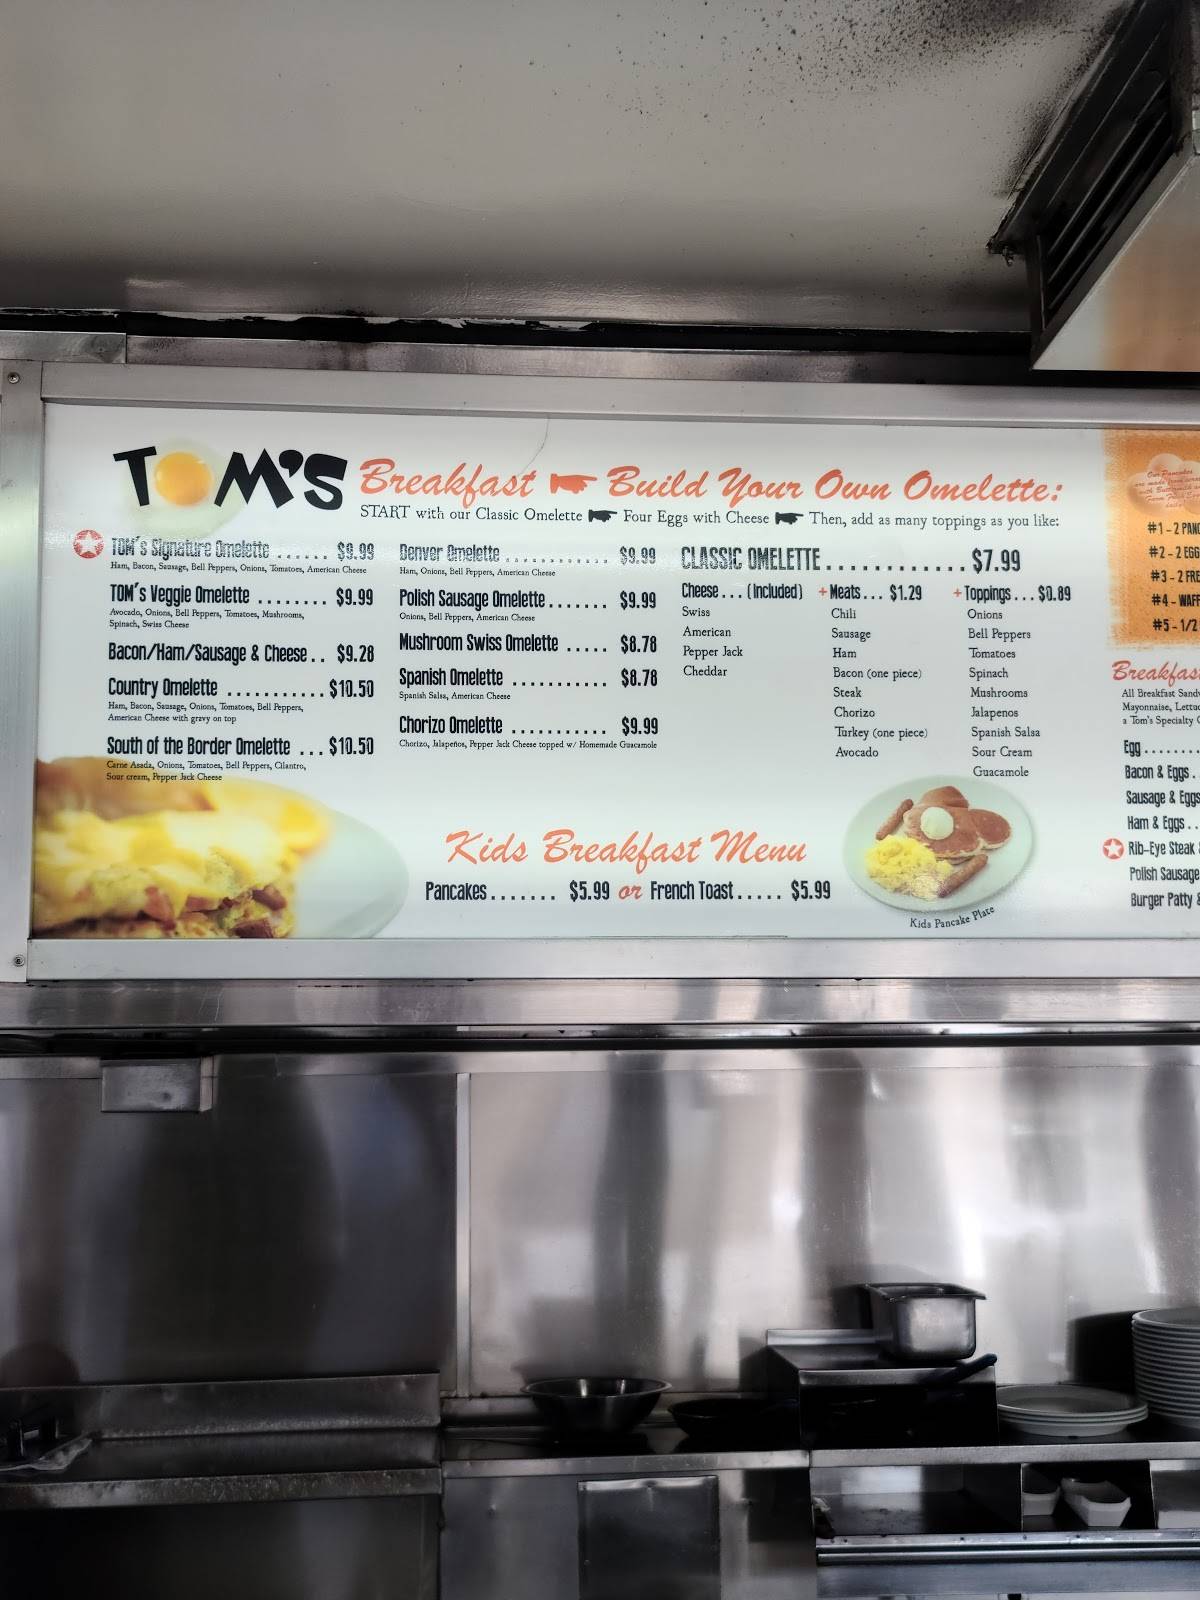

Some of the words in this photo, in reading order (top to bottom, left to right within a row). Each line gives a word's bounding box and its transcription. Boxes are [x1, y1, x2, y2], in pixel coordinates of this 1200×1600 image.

[360, 458, 537, 509] Breakfast
[607, 465, 709, 497] Build
[718, 467, 803, 508] Your
[815, 468, 891, 500] Own
[904, 470, 1062, 502] Omelette:
[361, 505, 410, 519] START
[416, 507, 444, 519] with
[476, 507, 518, 520] Classic
[524, 508, 582, 521] Omelette
[624, 510, 652, 522] Four
[657, 510, 688, 527] Eggs
[693, 511, 720, 523] with
[726, 511, 769, 523] Cheese
[809, 512, 846, 528] Then,
[851, 513, 873, 525] add
[879, 517, 890, 525] as
[895, 518, 927, 530] many
[933, 516, 986, 530] toppings
[991, 518, 1002, 526] as
[1008, 518, 1030, 530] you
[1034, 514, 1059, 527] like:
[152, 539, 211, 561] Signature
[216, 540, 269, 558] Omelette
[337, 542, 374, 561] $9.99
[400, 544, 443, 561] Denver
[447, 544, 499, 562] Omelette
[620, 546, 655, 564] $9.99
[682, 546, 742, 569] CLASSIC
[748, 547, 820, 570] OMELETTE
[972, 548, 1020, 573] $7.99
[400, 567, 418, 575] Ham,
[421, 567, 447, 576] Onions,
[466, 568, 494, 577] Peppers,
[151, 585, 191, 606] Veggie
[196, 586, 249, 603] Omelette
[336, 588, 373, 607] $9.99
[682, 583, 718, 598] Cheese
[748, 583, 802, 600] (Included)
[830, 584, 860, 599] Meats
[890, 584, 922, 602] $1.29
[964, 585, 1011, 604] Toppings
[1038, 585, 1071, 602] $0.89
[400, 589, 434, 606] Polish
[439, 590, 488, 611] Sausage
[493, 591, 545, 607] Omelette
[620, 591, 656, 610] $9.99
[110, 608, 142, 617] Avocado,
[145, 608, 173, 617] Onions,
[192, 609, 222, 619] Peppers,
[224, 610, 259, 619] Tomatoes,
[262, 610, 304, 619] Mushrooms,
[683, 606, 710, 616] Swiss
[831, 608, 856, 618] Chili
[967, 609, 1002, 619] Onions
[683, 626, 731, 636] American
[1153, 619, 1169, 631] #5
[1181, 619, 1197, 631] 1/2
[832, 628, 870, 642] Sausage
[968, 628, 988, 638] Bell
[992, 628, 1030, 642] Peppers
[400, 633, 462, 651] Mushroom
[467, 634, 502, 651] Swiss
[506, 634, 558, 651] Omelette
[621, 635, 656, 654] $8.78
[109, 642, 246, 665] Bacon/Ham/Sausage
[265, 645, 307, 662] Cheese
[337, 644, 374, 663] $9.28
[684, 646, 718, 660] Pepper
[723, 646, 743, 656] Jack
[833, 648, 856, 658] Ham
[969, 648, 1015, 658] Tomatoes
[684, 665, 727, 676] Cheddar
[833, 667, 863, 677] Bacon
[867, 669, 888, 679] (one
[893, 669, 921, 679] piece)
[969, 667, 1008, 681] Spinach
[400, 668, 446, 688] Spanish
[450, 668, 503, 686] Omelette
[621, 668, 657, 688] $8.78
[109, 678, 158, 698] Country
[163, 678, 217, 696] Omelette
[330, 679, 374, 699] $10.50
[833, 687, 861, 697] Steak
[971, 687, 1028, 697] Mushrooms
[1122, 689, 1134, 697] All
[1138, 689, 1175, 697] Breakfast
[109, 702, 127, 710] Ham,
[130, 702, 154, 711] Bacon,
[157, 702, 186, 712] Sausage,
[189, 702, 216, 711] Onions,
[219, 703, 254, 712] Tomatoes,
[274, 703, 303, 713] Peppers,
[834, 707, 875, 717] Chorizo
[971, 707, 1018, 721] Jalapenos
[1123, 702, 1172, 713] Mayonnaise,
[400, 716, 445, 733] Chorizo
[450, 716, 502, 734] Omelette
[622, 716, 658, 736] $9.99
[1130, 716, 1153, 724] Tom's
[1156, 716, 1193, 727] Specialty
[835, 727, 869, 740] Turkey
[873, 728, 894, 738] (one
[899, 728, 927, 740] piece)
[972, 727, 1011, 740] Spanish
[1015, 727, 1040, 737] Salsa
[108, 737, 142, 754] South
[147, 737, 159, 754] of
[164, 737, 183, 754] the
[188, 737, 232, 755] Border
[236, 737, 290, 755] Omelette
[329, 736, 373, 756] $10.50
[836, 747, 878, 757] Avocado
[972, 746, 996, 757] Sour
[1000, 746, 1032, 756] Cream
[1124, 740, 1141, 757] Egg
[973, 766, 1028, 776] Guacamole
[1125, 765, 1153, 779] Bacon
[1167, 765, 1189, 782] Eggs
[1127, 791, 1165, 807] Sausage
[1180, 790, 1200, 807] Eggs
[446, 831, 528, 864] Kids
[543, 829, 702, 875] Breakfast
[711, 830, 806, 864] Menu
[1129, 841, 1166, 858] Rib-Eye
[1169, 841, 1195, 855] Steak
[1130, 867, 1157, 880] Polish
[1161, 867, 1199, 884] Sausage
[426, 882, 486, 900] Pancakes
[570, 880, 609, 902] $5.99
[619, 885, 643, 899] or
[651, 881, 694, 900] French
[699, 881, 733, 900] Toast
[791, 880, 830, 901] $5.99
[1131, 893, 1164, 910] Burger
[1168, 892, 1192, 909] Patty
[910, 918, 931, 928] Kids
[935, 916, 970, 928] Pancake
[972, 906, 994, 920] Plate
